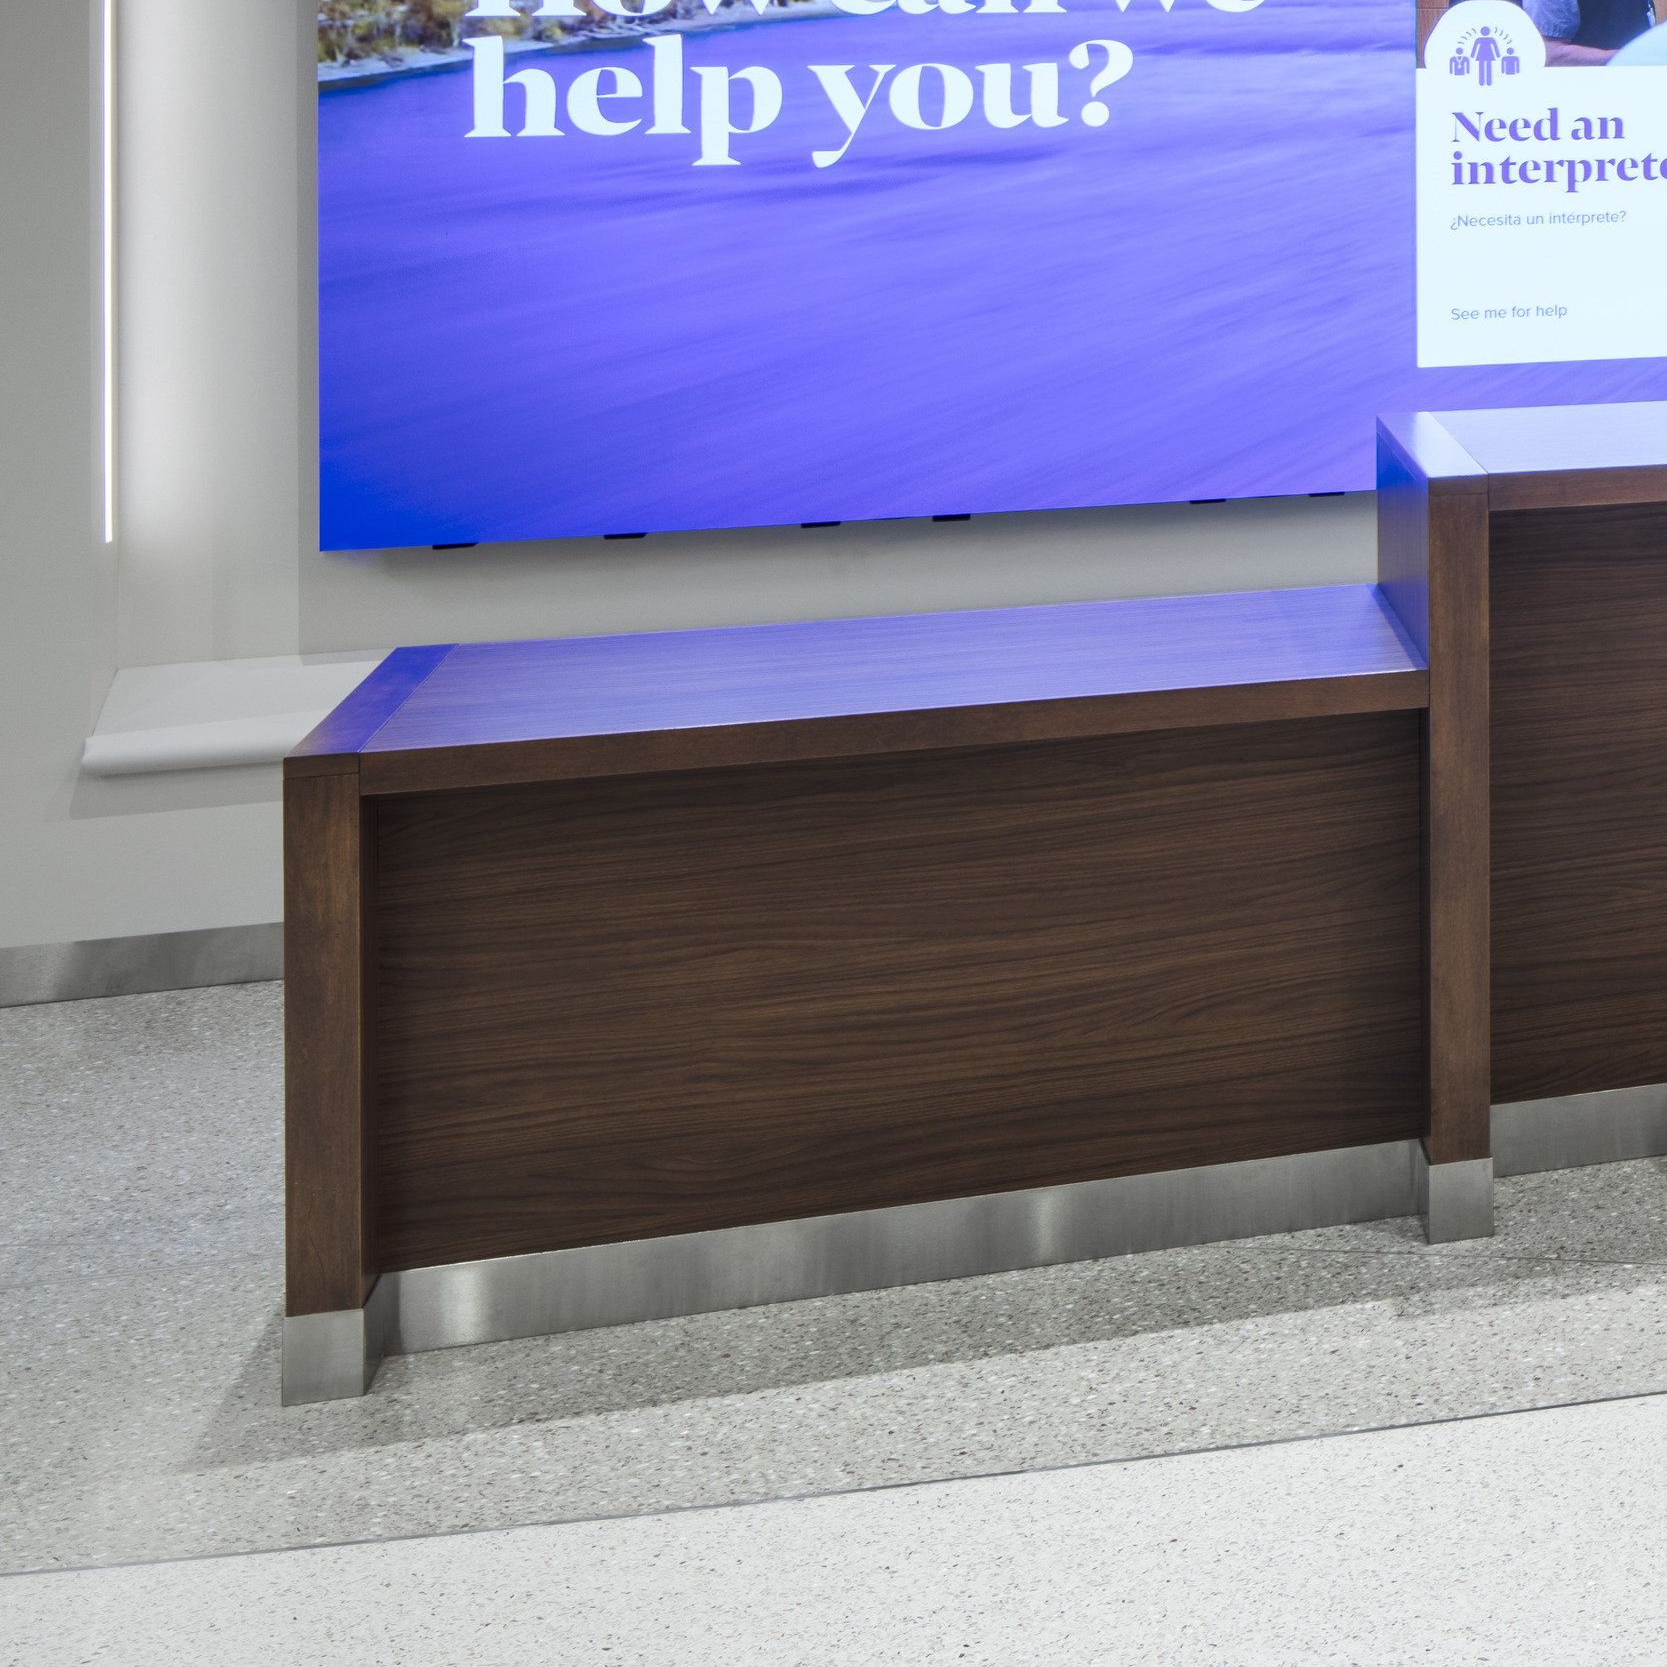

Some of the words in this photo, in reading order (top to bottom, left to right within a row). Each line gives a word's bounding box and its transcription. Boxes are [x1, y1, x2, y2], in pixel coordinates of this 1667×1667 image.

[464, 34, 783, 166] help
[808, 40, 1133, 169] you?
[1451, 107, 1561, 142] Need
[1571, 116, 1626, 140] an
[1450, 214, 1521, 231] ¿Necesita
[1526, 215, 1544, 226] un
[1550, 210, 1627, 226] intérprete?
[1451, 308, 1479, 320] See
[1484, 309, 1507, 320] me
[1512, 306, 1531, 318] for
[1536, 304, 1568, 319] help
